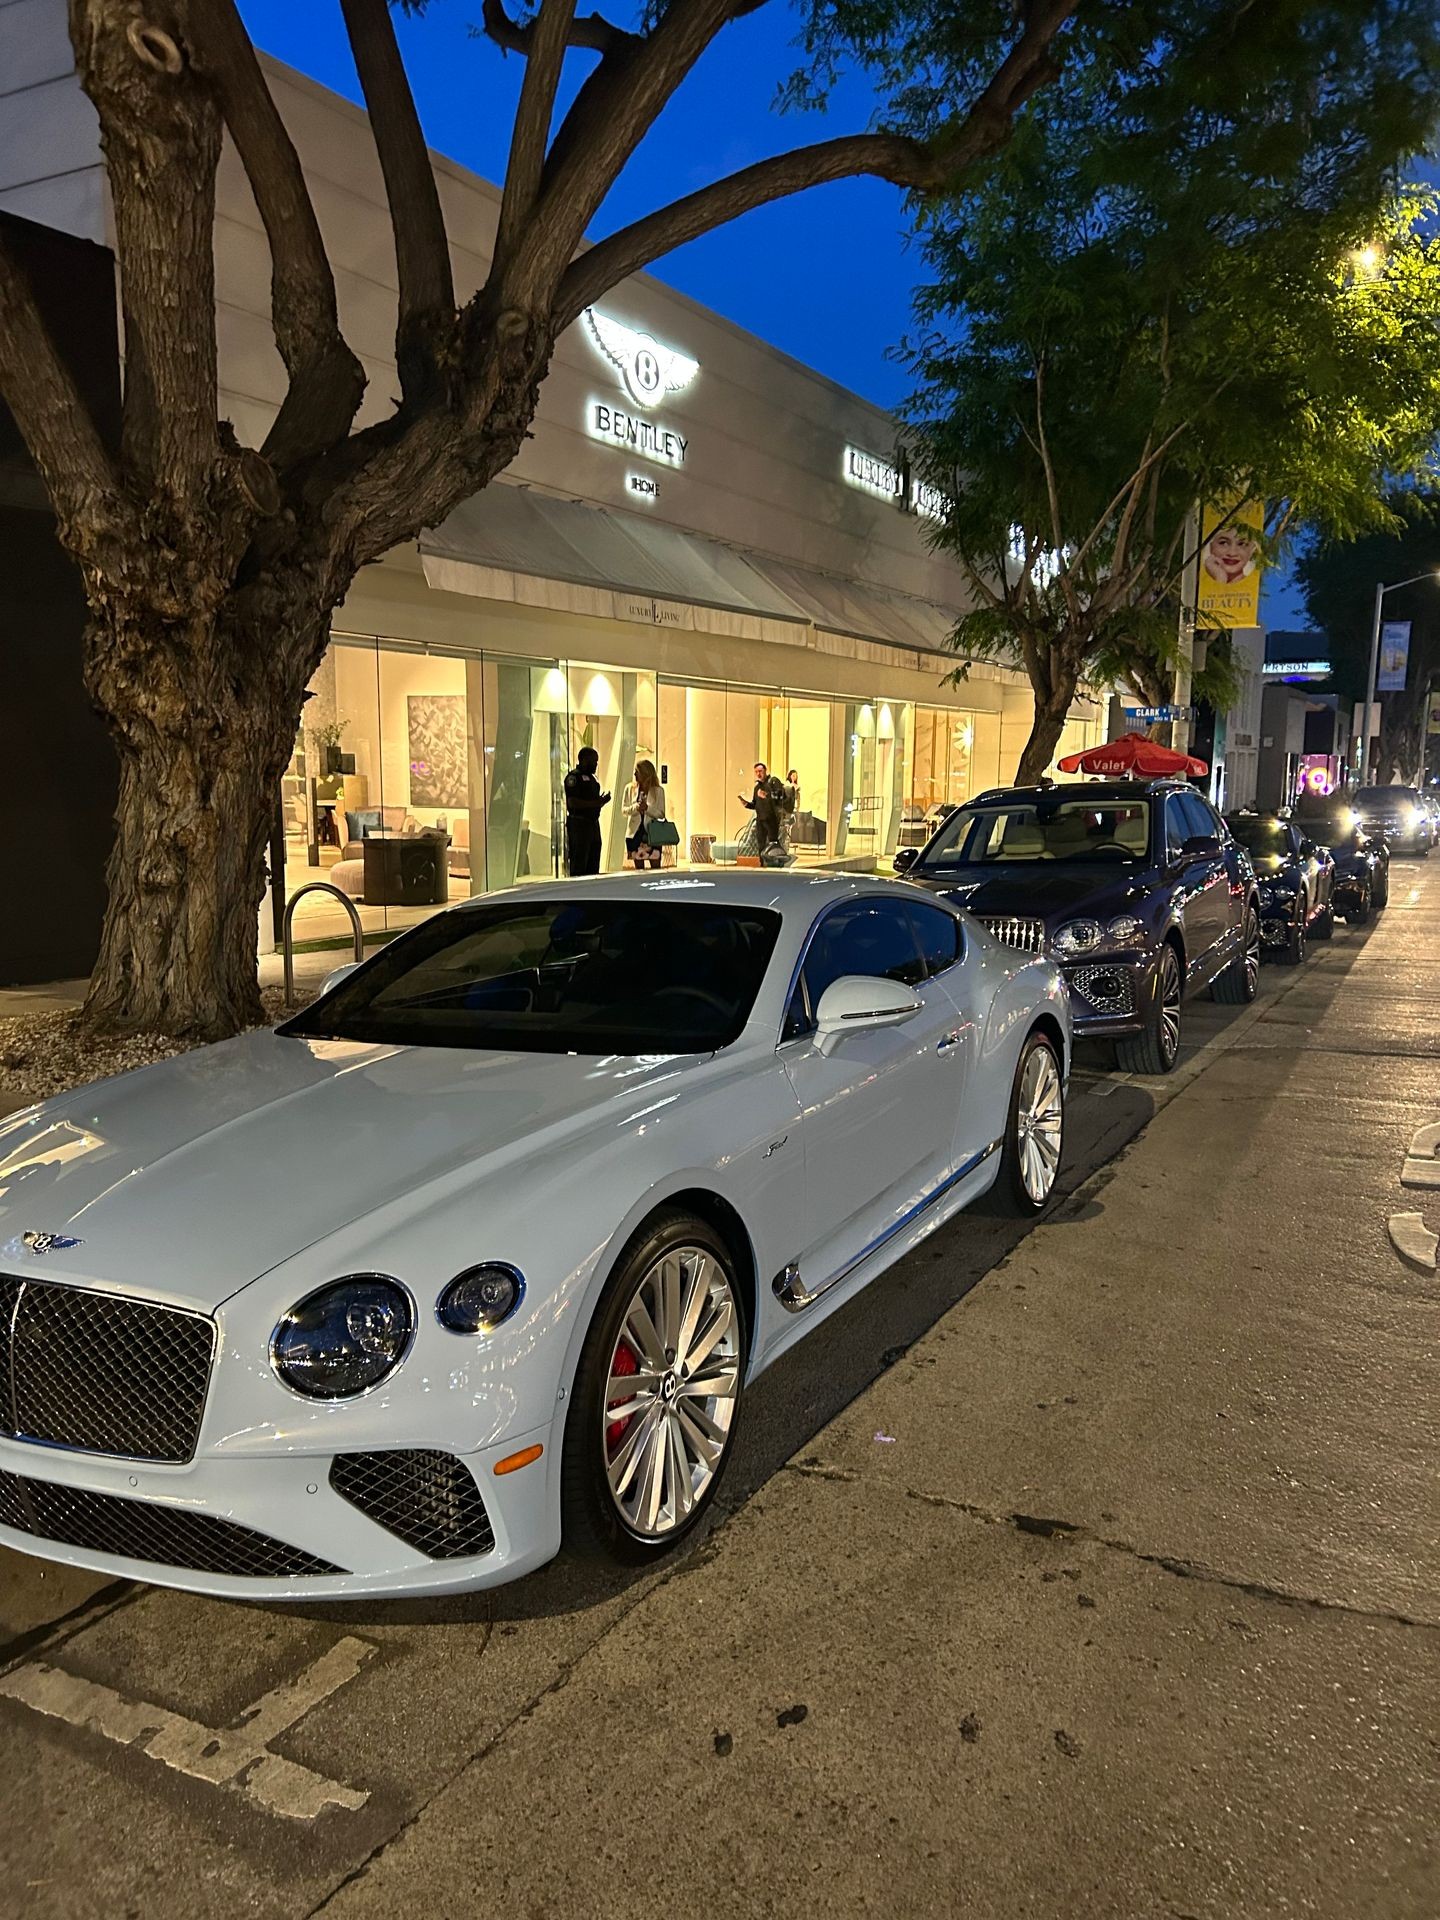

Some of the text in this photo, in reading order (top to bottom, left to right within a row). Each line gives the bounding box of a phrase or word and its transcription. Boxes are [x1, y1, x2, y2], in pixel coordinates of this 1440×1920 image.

[595, 404, 689, 462] BENTLEY
[631, 476, 661, 497] HOME
[1201, 597, 1252, 609] BEAUTY
[629, 604, 651, 617] LUXURY
[1135, 708, 1161, 717] CLARK
[1093, 759, 1126, 771] Valet
